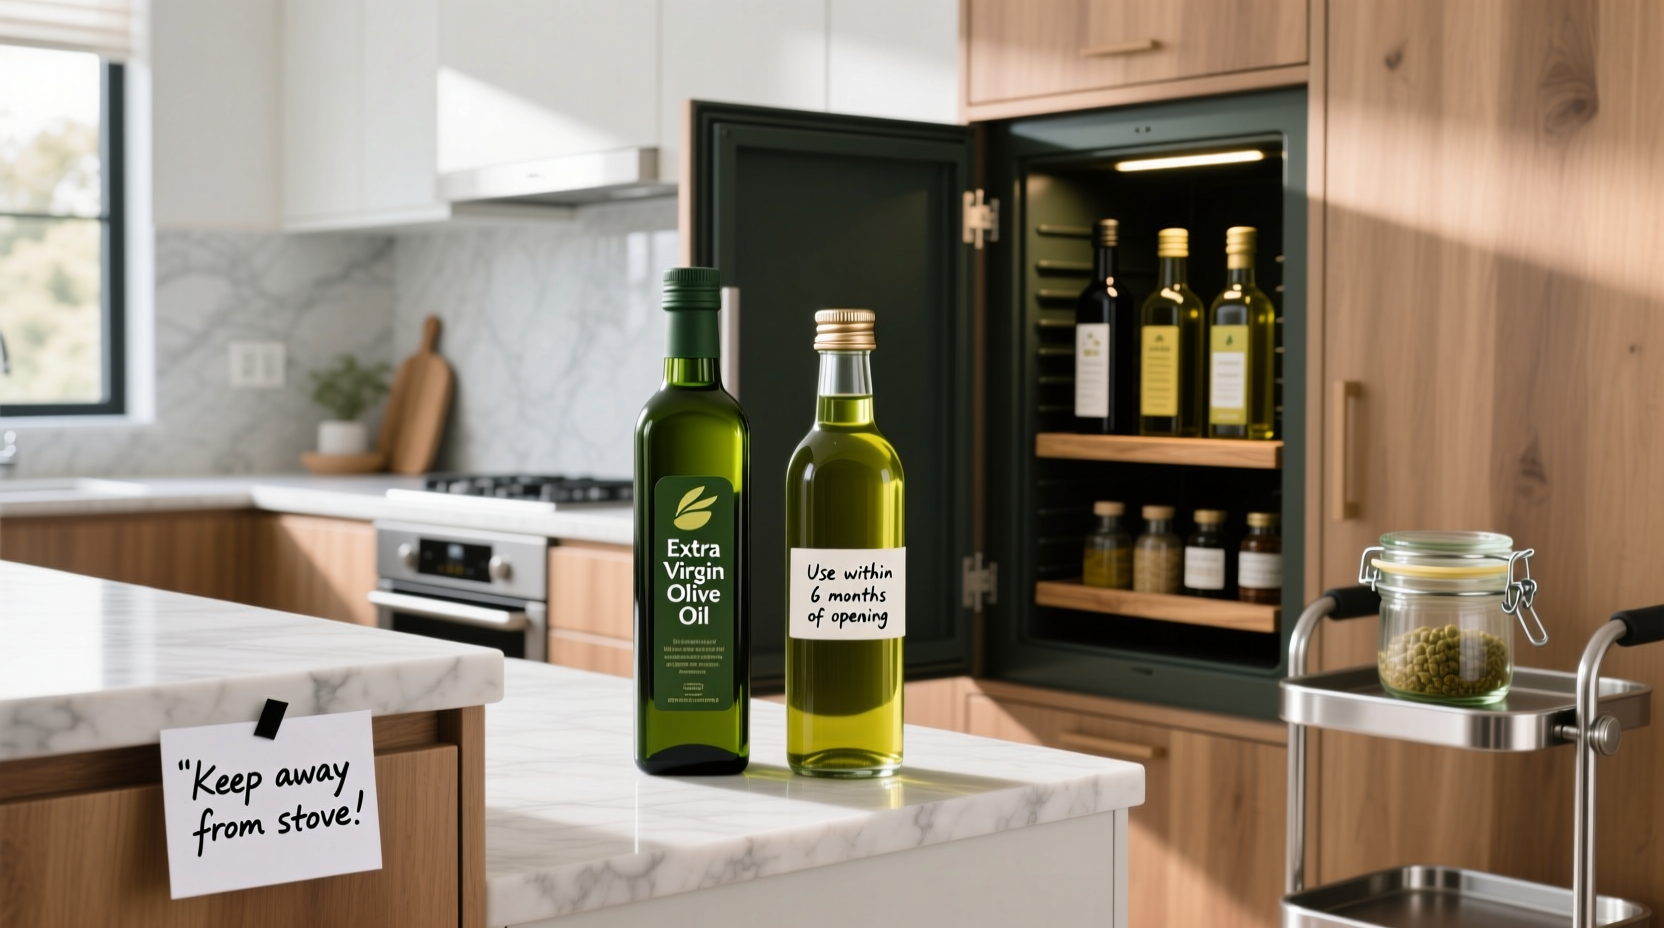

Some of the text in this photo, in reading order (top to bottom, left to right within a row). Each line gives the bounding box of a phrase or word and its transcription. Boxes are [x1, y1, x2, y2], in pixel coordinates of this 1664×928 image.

[667, 538, 721, 558] Extra
[662, 561, 725, 585] Virgin
[807, 561, 893, 581] Use within
[666, 583, 721, 603] Olive
[810, 585, 887, 604] 6 months
[678, 605, 709, 626] Oil
[807, 607, 889, 630] of opening
[274, 760, 351, 798] away
[192, 789, 365, 858] from stove!
